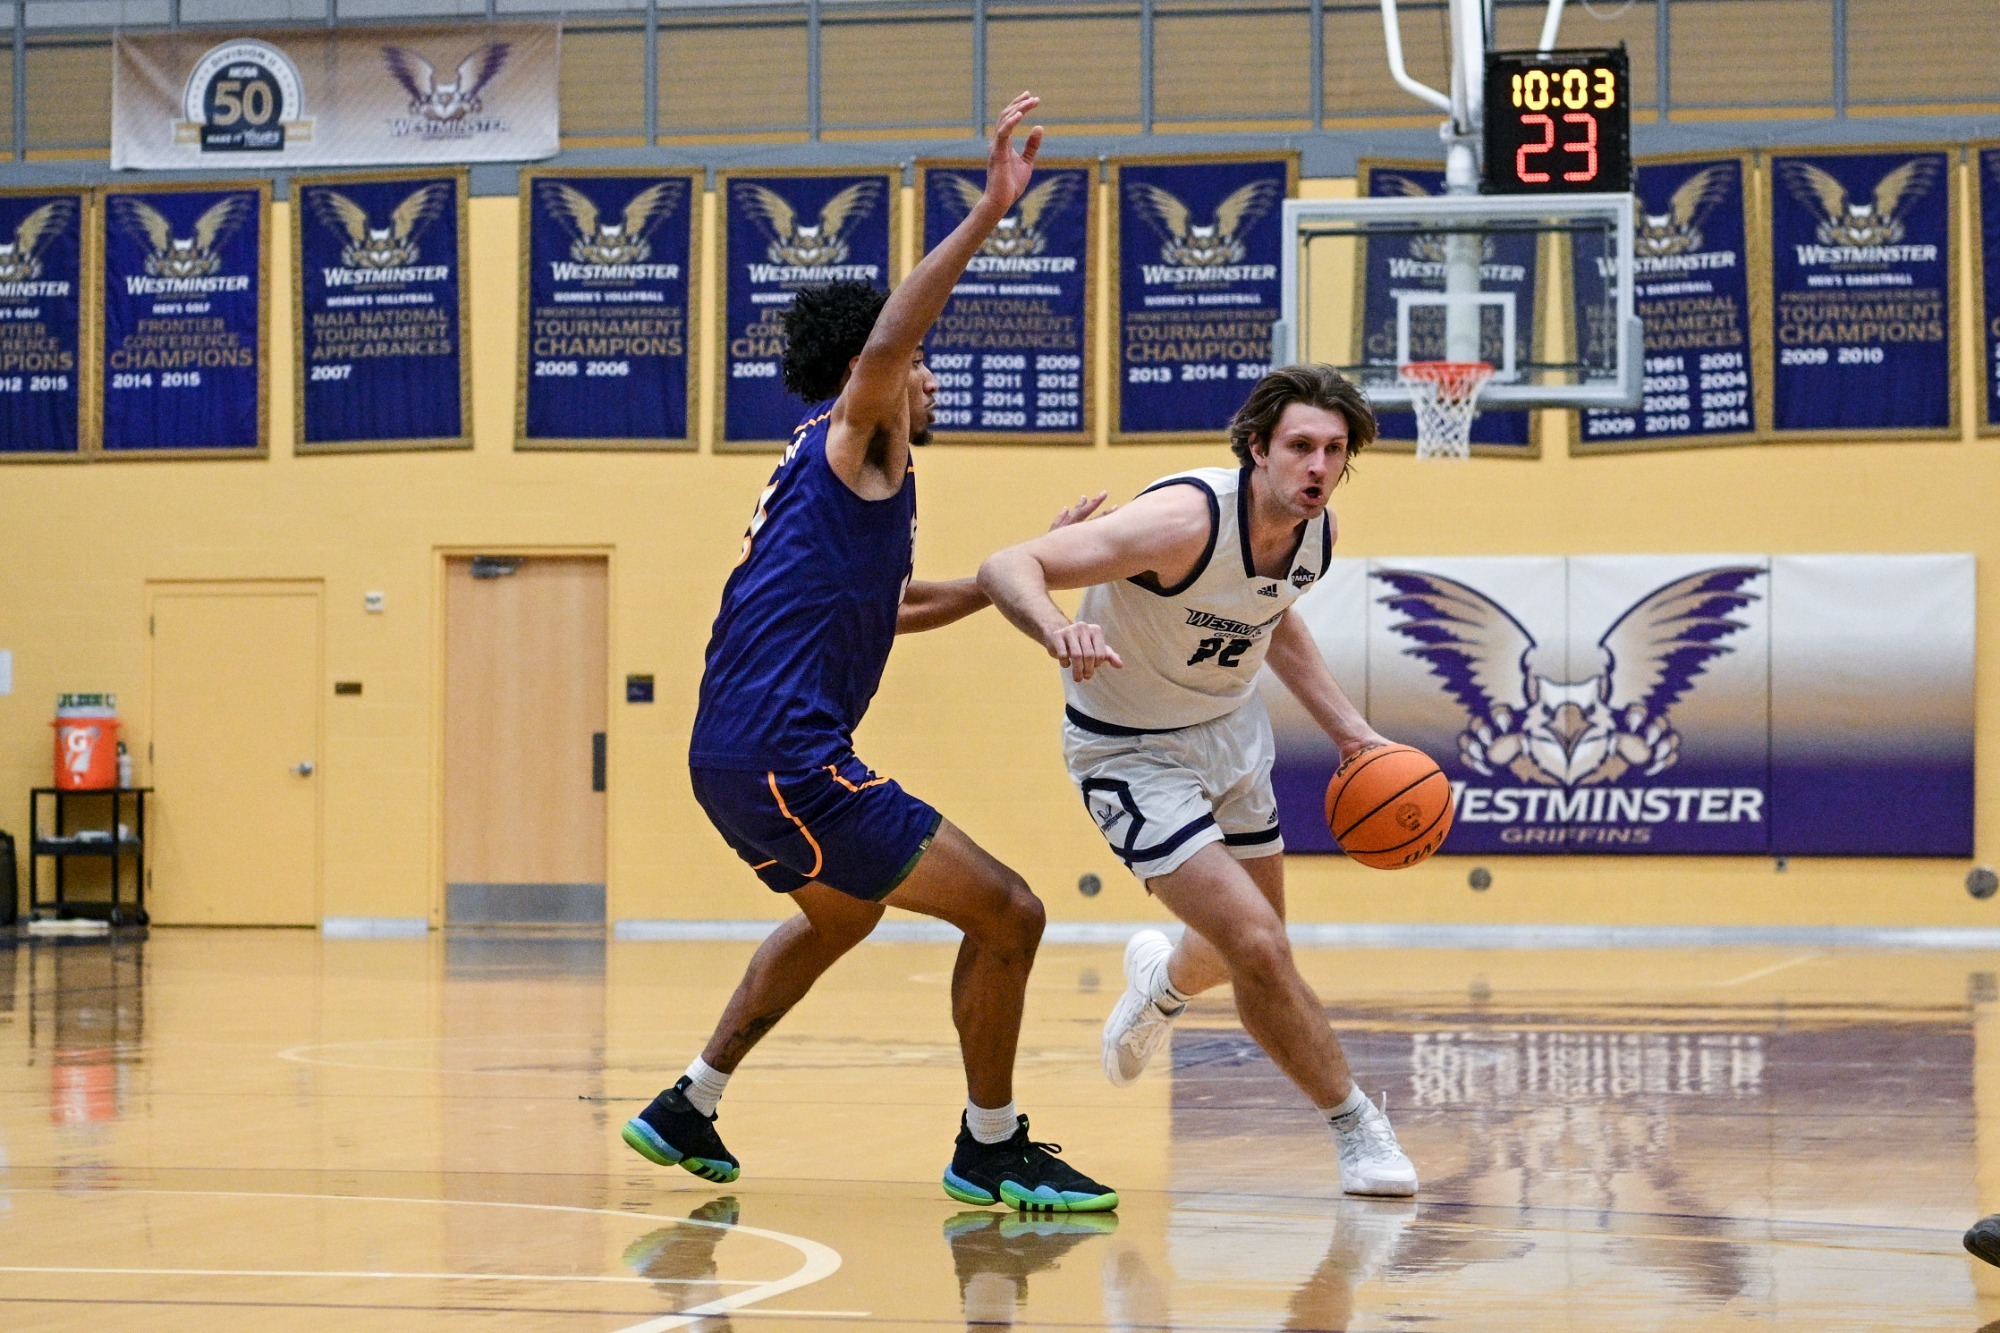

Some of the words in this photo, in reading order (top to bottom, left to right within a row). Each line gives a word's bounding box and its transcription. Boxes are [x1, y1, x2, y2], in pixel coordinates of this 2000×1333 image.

[1512, 68, 1615, 111] 10:03
[212, 80, 274, 126] 50
[1516, 113, 1597, 183] 23
[965, 256, 1077, 273] ESTMINSTER
[1596, 250, 1736, 277] WSTMINSTER
[1797, 244, 1938, 266] WESTMINSTER
[323, 265, 449, 288] WESTMINSTER
[551, 261, 680, 281] WESTMINSTER
[748, 263, 879, 283] WESTMINSTER
[1142, 264, 1276, 285] WESTMINSTER
[1390, 257, 1526, 282] WESTSTER
[0, 280, 70, 297] MINSTER
[127, 275, 249, 295] WESTMINSTER
[360, 308, 448, 324] NATIONAL
[1779, 302, 1943, 321] TOURNAMENT
[314, 324, 447, 343] TOURNAMENT
[534, 319, 683, 336] TOURNAMENT
[1779, 320, 1943, 344] CHAMPIONS
[312, 339, 452, 360] APPEARANCES
[534, 337, 683, 356] CHAMPIONS
[1837, 347, 1884, 364] 2010
[3, 351, 73, 371] PIONS
[110, 348, 253, 369] CHAMPIONS
[930, 353, 974, 370] 2007
[112, 372, 152, 389] 2014
[310, 364, 352, 381] 2007
[983, 372, 1022, 388] 2011
[1036, 373, 1079, 389] 2012
[1181, 364, 1228, 381] 2014
[1236, 363, 1270, 379] 201
[982, 391, 1025, 407] 2014
[981, 409, 1027, 426] 2020
[1035, 411, 1078, 427] 2021
[1645, 414, 1690, 433] 2010
[1501, 827, 1652, 844] GRIFFINS
